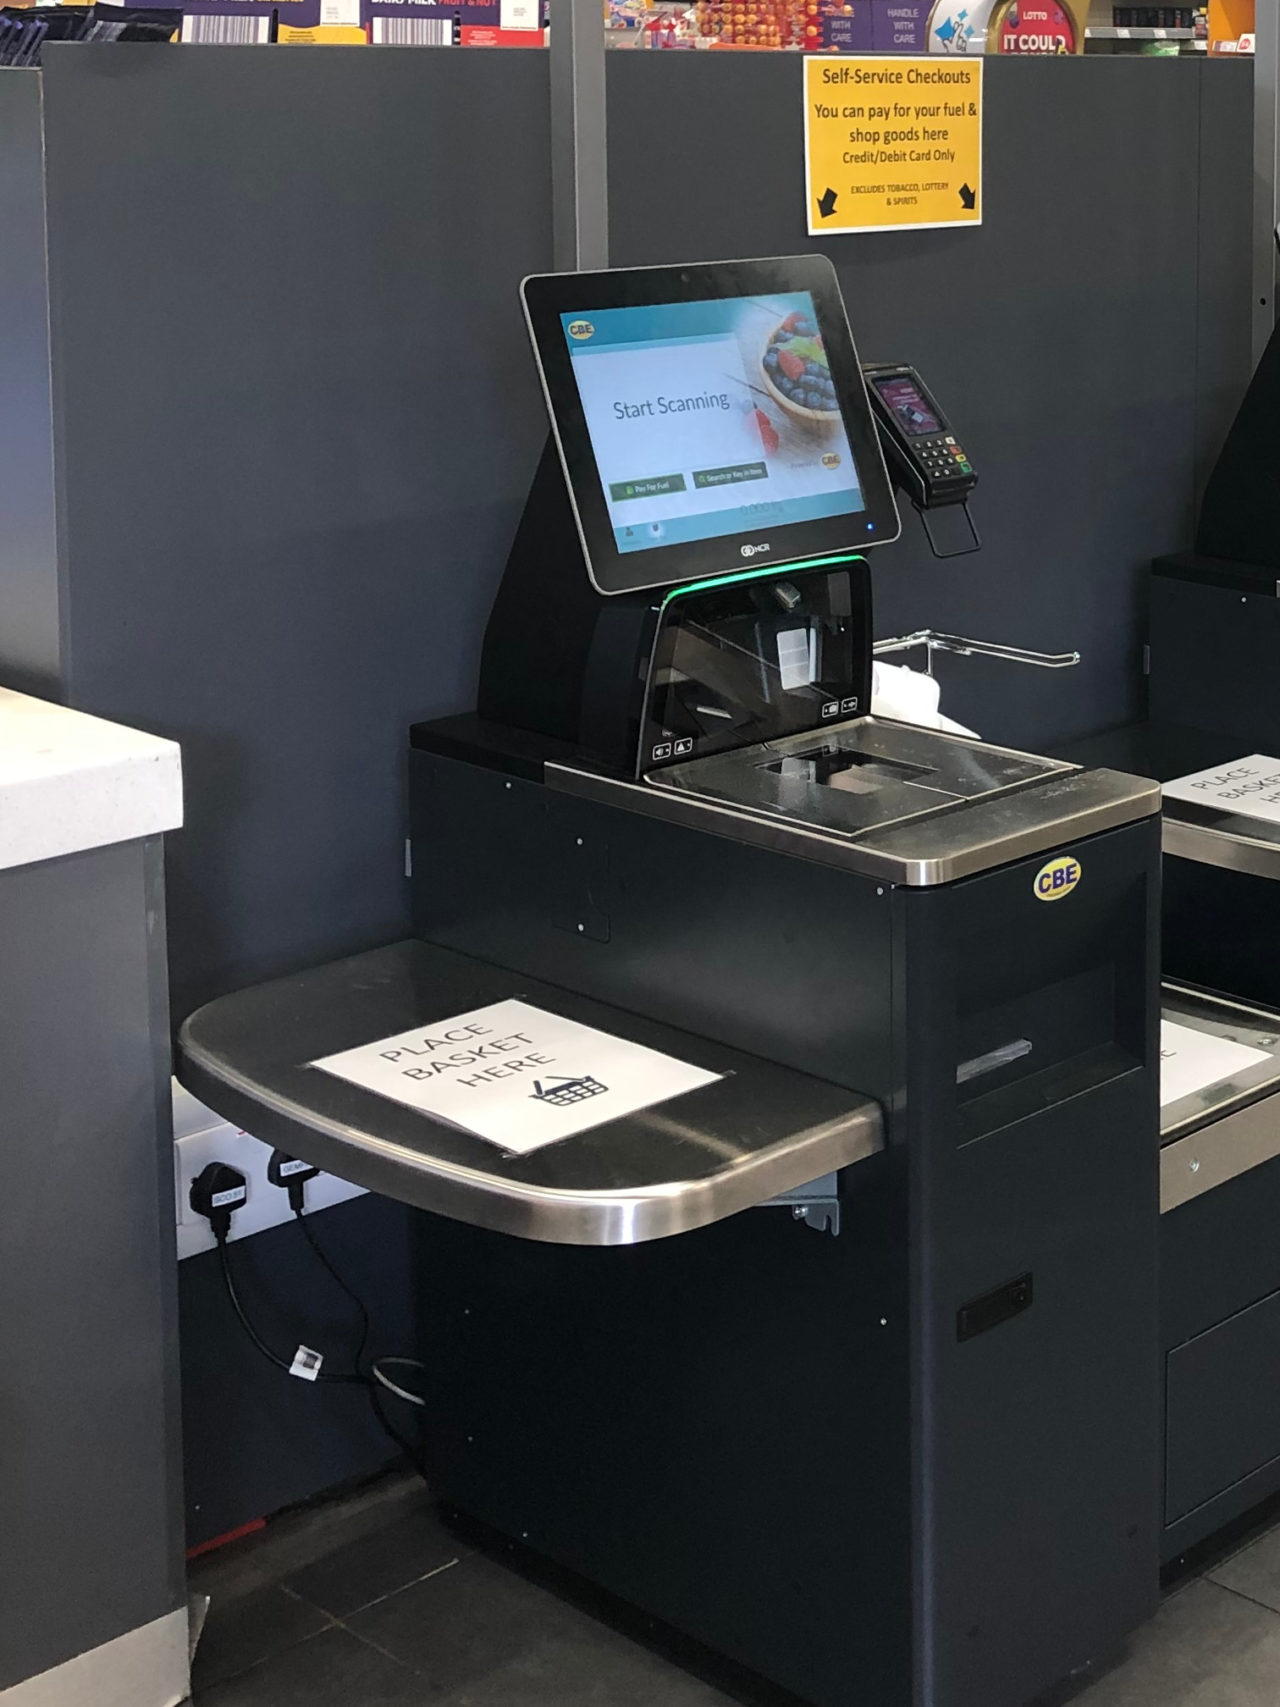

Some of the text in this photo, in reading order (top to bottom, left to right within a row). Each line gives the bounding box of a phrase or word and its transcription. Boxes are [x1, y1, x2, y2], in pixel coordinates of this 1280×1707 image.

[887, 8, 919, 18] HANDLE
[1023, 11, 1048, 20] LOTTO
[831, 20, 851, 29] WITH
[893, 21, 915, 30] WITH
[830, 33, 852, 42] CARE
[893, 34, 916, 43] CARE
[1003, 34, 1017, 50] IT
[823, 68, 971, 84] Self-Service Checkouts
[814, 102, 977, 121] You can pay for your fuel &
[849, 127, 948, 145] shop goods here
[842, 148, 955, 165] Credit/Debit Card Only
[851, 184, 885, 194] EXCLUDES
[921, 182, 949, 192] LOTTERY
[886, 196, 917, 206] & SPIRITS
[570, 324, 593, 335] CBE
[613, 392, 731, 420] Start Scanning
[634, 485, 646, 493] Pay
[656, 480, 670, 489] Fuel
[754, 543, 770, 552] NCR
[1191, 766, 1260, 790] PLACE
[1038, 862, 1077, 894] CBE
[379, 1022, 495, 1063] PLACE
[401, 1032, 535, 1081] BASKET
[456, 1052, 557, 1088] HERE
